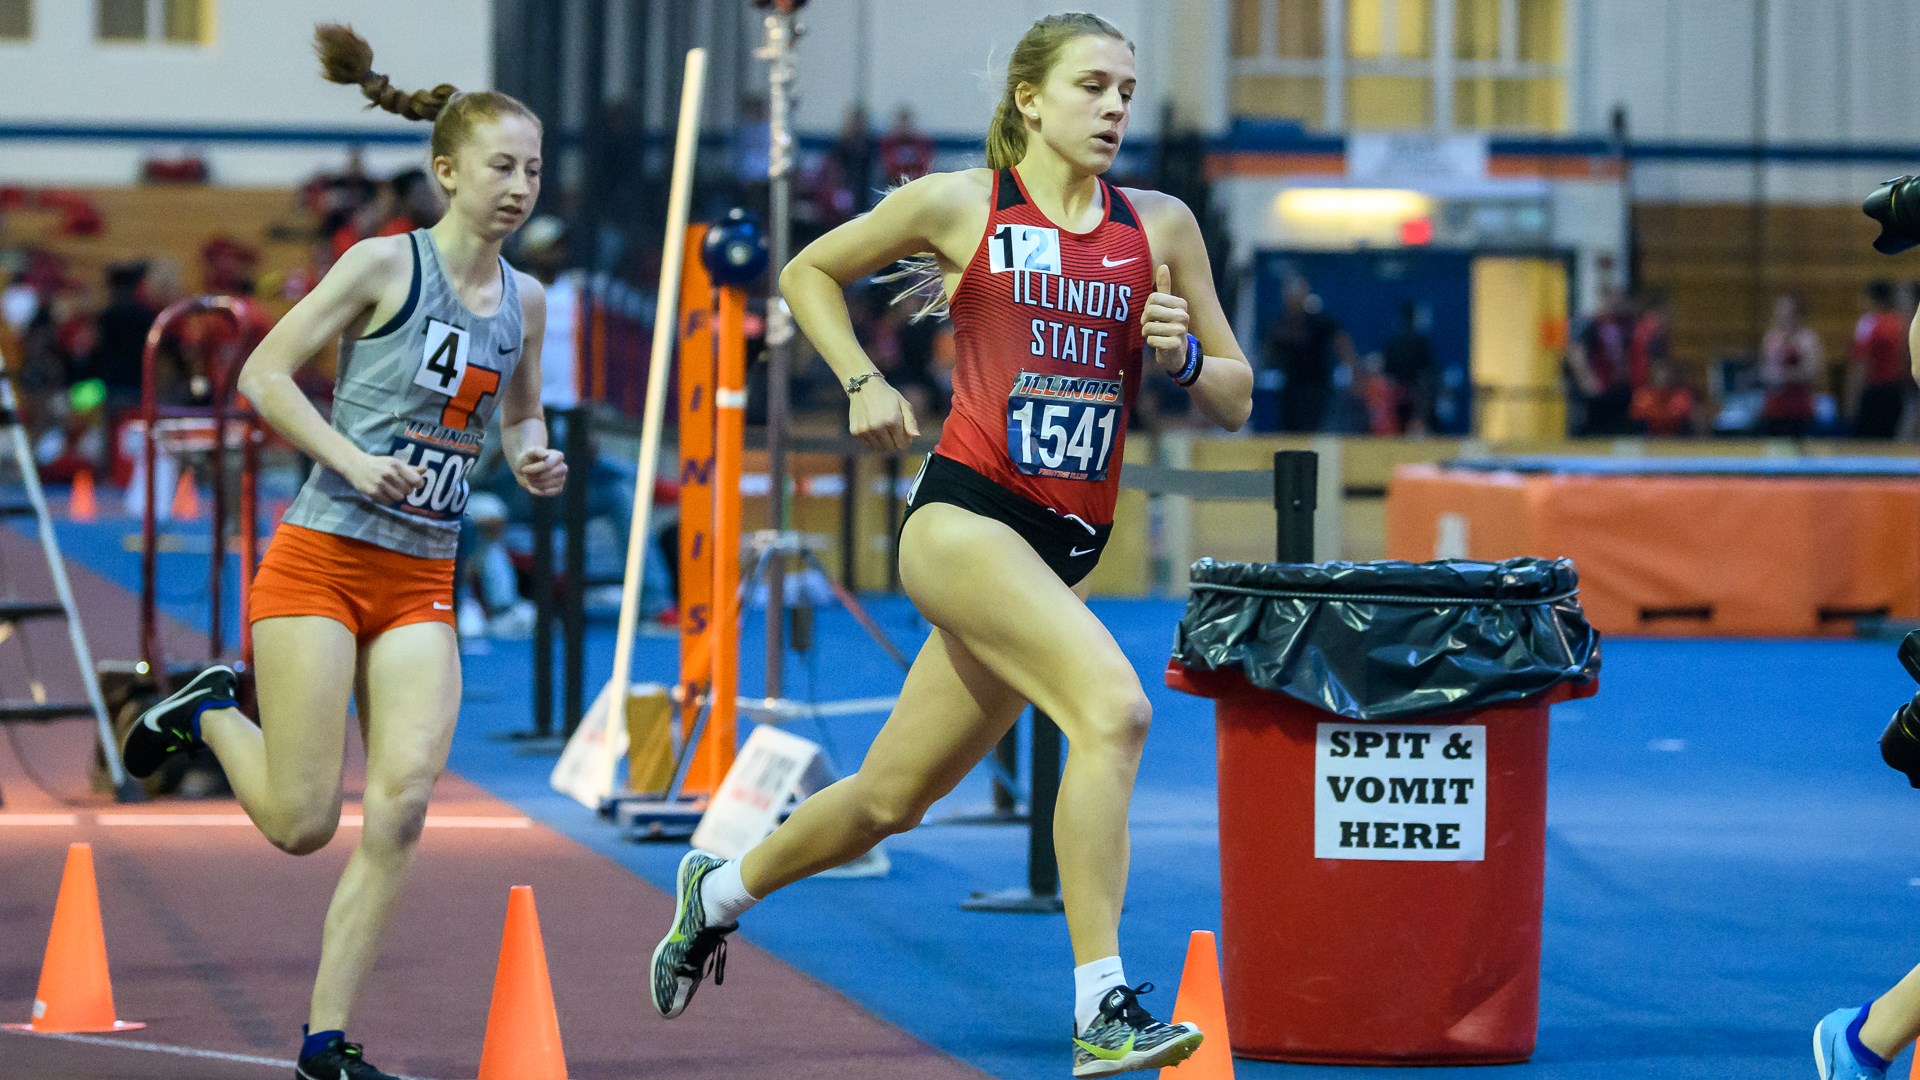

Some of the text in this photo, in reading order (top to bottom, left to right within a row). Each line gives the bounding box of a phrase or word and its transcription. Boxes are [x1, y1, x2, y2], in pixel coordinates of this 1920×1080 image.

[993, 226, 1051, 271] 12
[1013, 269, 1132, 323] ILLINOIS
[425, 331, 460, 388] 4
[1030, 318, 1110, 370] STATE
[1020, 374, 1121, 402] ILLINOIS
[1012, 401, 1116, 471] 1541
[1330, 731, 1473, 760] SPIT &
[1327, 775, 1474, 804] VOMIT
[1339, 821, 1460, 849] HERE
